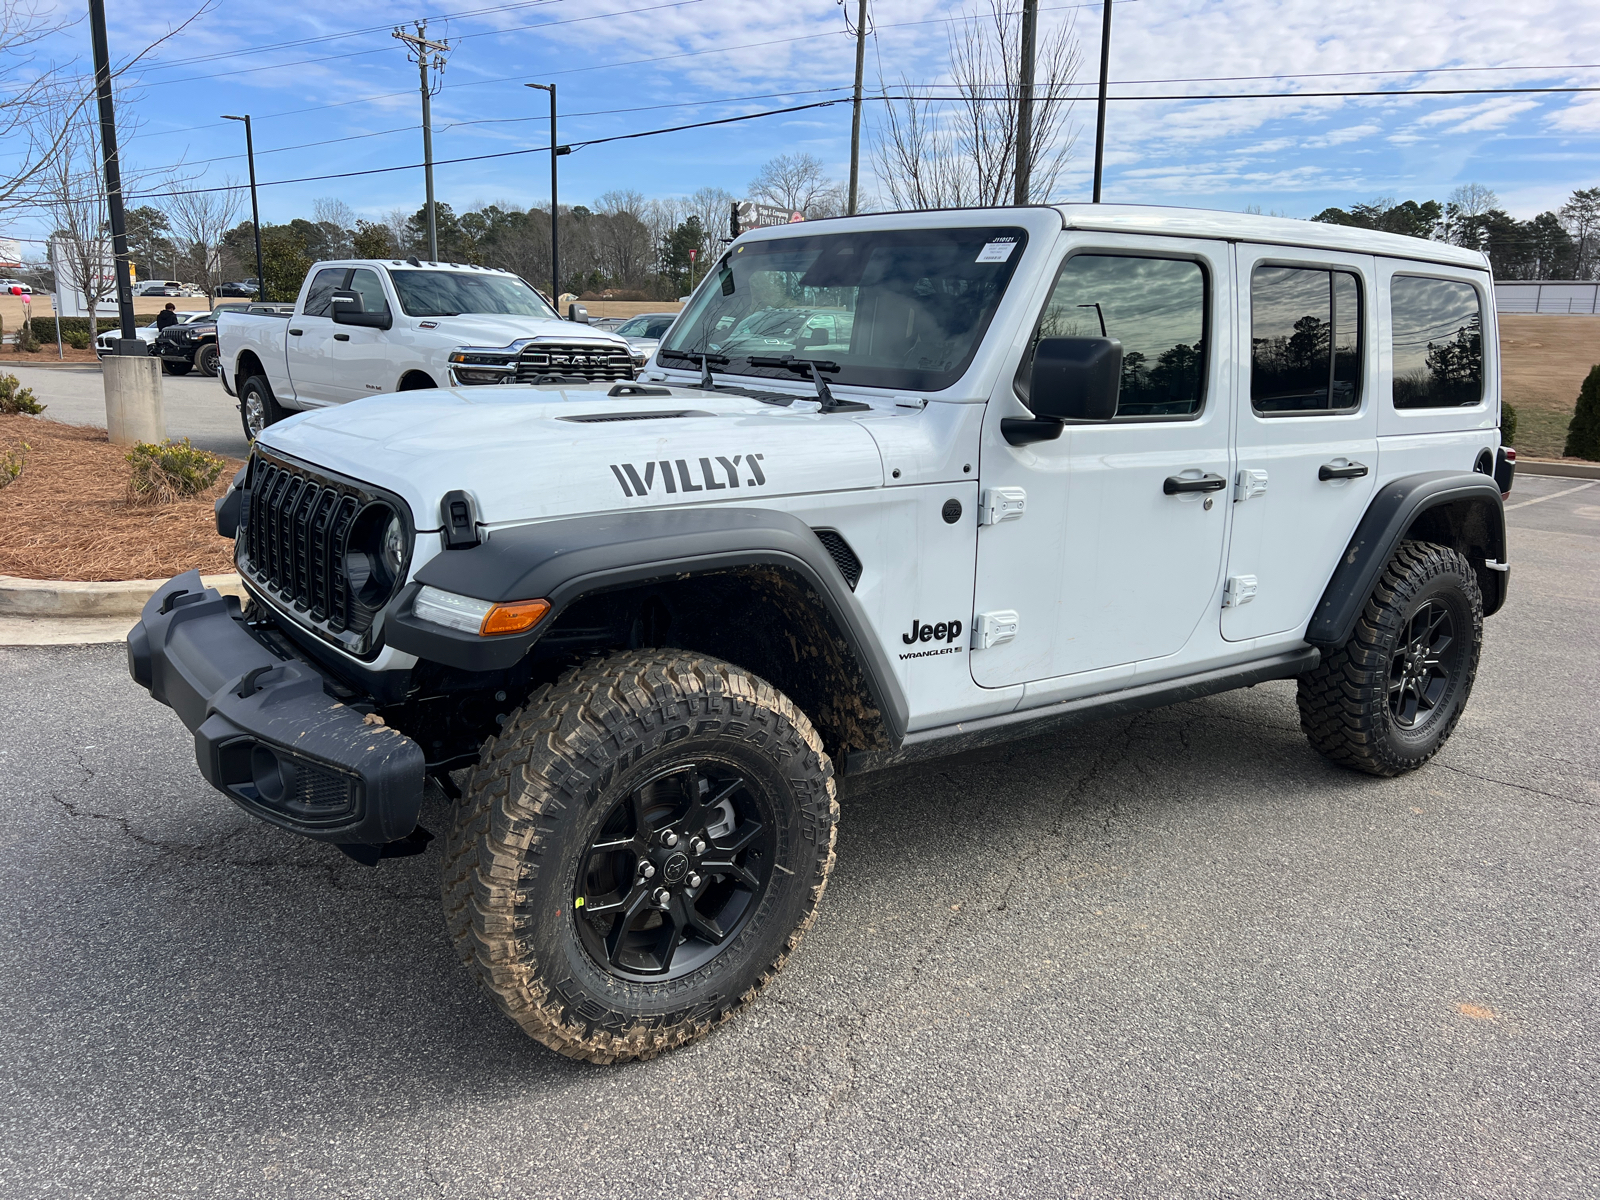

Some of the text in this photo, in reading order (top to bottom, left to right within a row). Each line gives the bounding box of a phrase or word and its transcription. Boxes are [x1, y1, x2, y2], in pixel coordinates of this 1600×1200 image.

[551, 355, 607, 366] RAM
[609, 453, 766, 498] WILLYS
[902, 619, 962, 644] Jeep
[899, 647, 953, 660] WRANGLER
[586, 719, 793, 803] WILDPEAK
